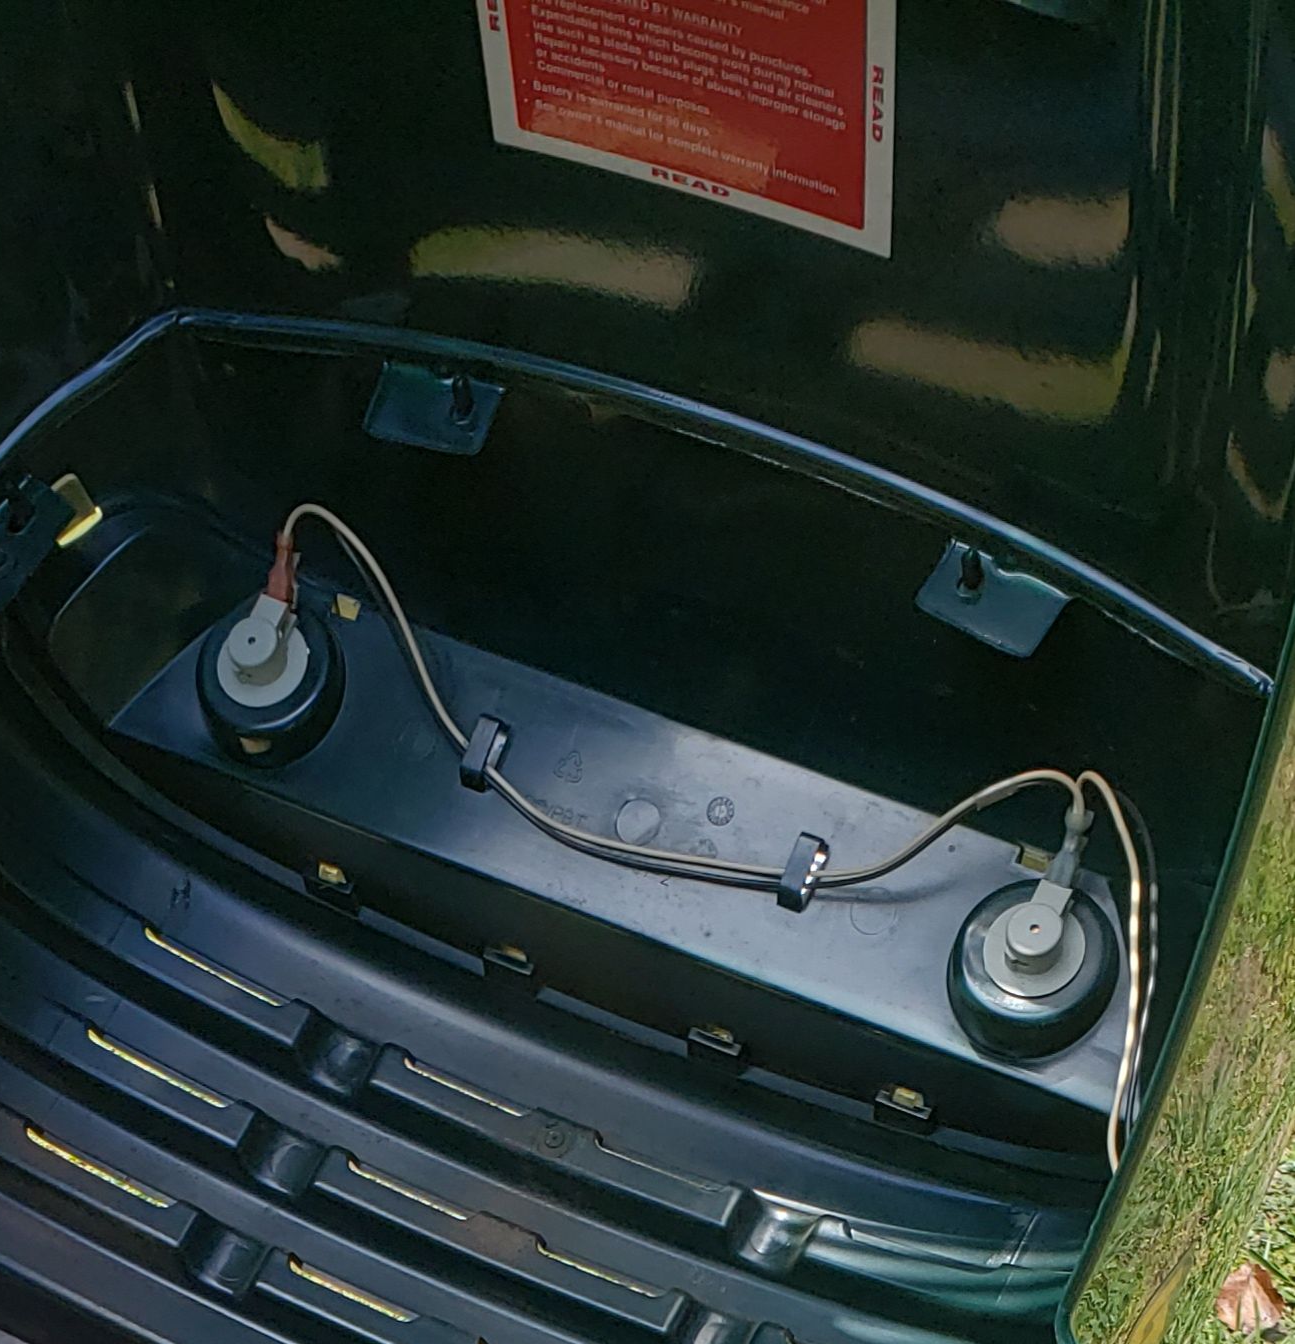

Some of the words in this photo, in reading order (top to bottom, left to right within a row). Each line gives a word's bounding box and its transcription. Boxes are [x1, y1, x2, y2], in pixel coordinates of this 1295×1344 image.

[487, 0, 501, 32] RE
[671, 7, 742, 36] WARRANTY
[531, 4, 599, 31] Expendable
[601, 22, 632, 40] items
[635, 32, 671, 51] which
[672, 41, 718, 63] become
[721, 57, 750, 74] worn
[753, 66, 791, 89] during
[794, 79, 835, 99] normal
[533, 20, 554, 33] use
[556, 24, 585, 40] such
[587, 34, 601, 45] as
[648, 49, 680, 66] spark
[721, 69, 750, 87] belts
[753, 80, 775, 94] and
[777, 87, 792, 99] air
[536, 47, 547, 58] or
[628, 17, 640, 28] or
[643, 22, 684, 39] repairs
[686, 33, 728, 53] caused
[732, 44, 746, 60] by
[749, 51, 812, 77] punctures.
[532, 80, 573, 101] Battery
[587, 97, 645, 118] warranted
[647, 109, 663, 123] for
[534, 32, 578, 52] Repairs
[580, 45, 639, 72] necessary
[641, 61, 689, 82] because
[692, 75, 704, 87] of
[747, 91, 800, 117] improper
[802, 107, 846, 131] storage
[537, 60, 605, 86] Commercial
[607, 79, 619, 91] or
[622, 82, 655, 99] rental
[872, 65, 884, 143] READ
[535, 98, 557, 113] See
[604, 118, 646, 137] manual
[649, 128, 664, 142] for
[667, 136, 719, 158] complete
[720, 151, 769, 176] warranty
[651, 166, 730, 198] READ
